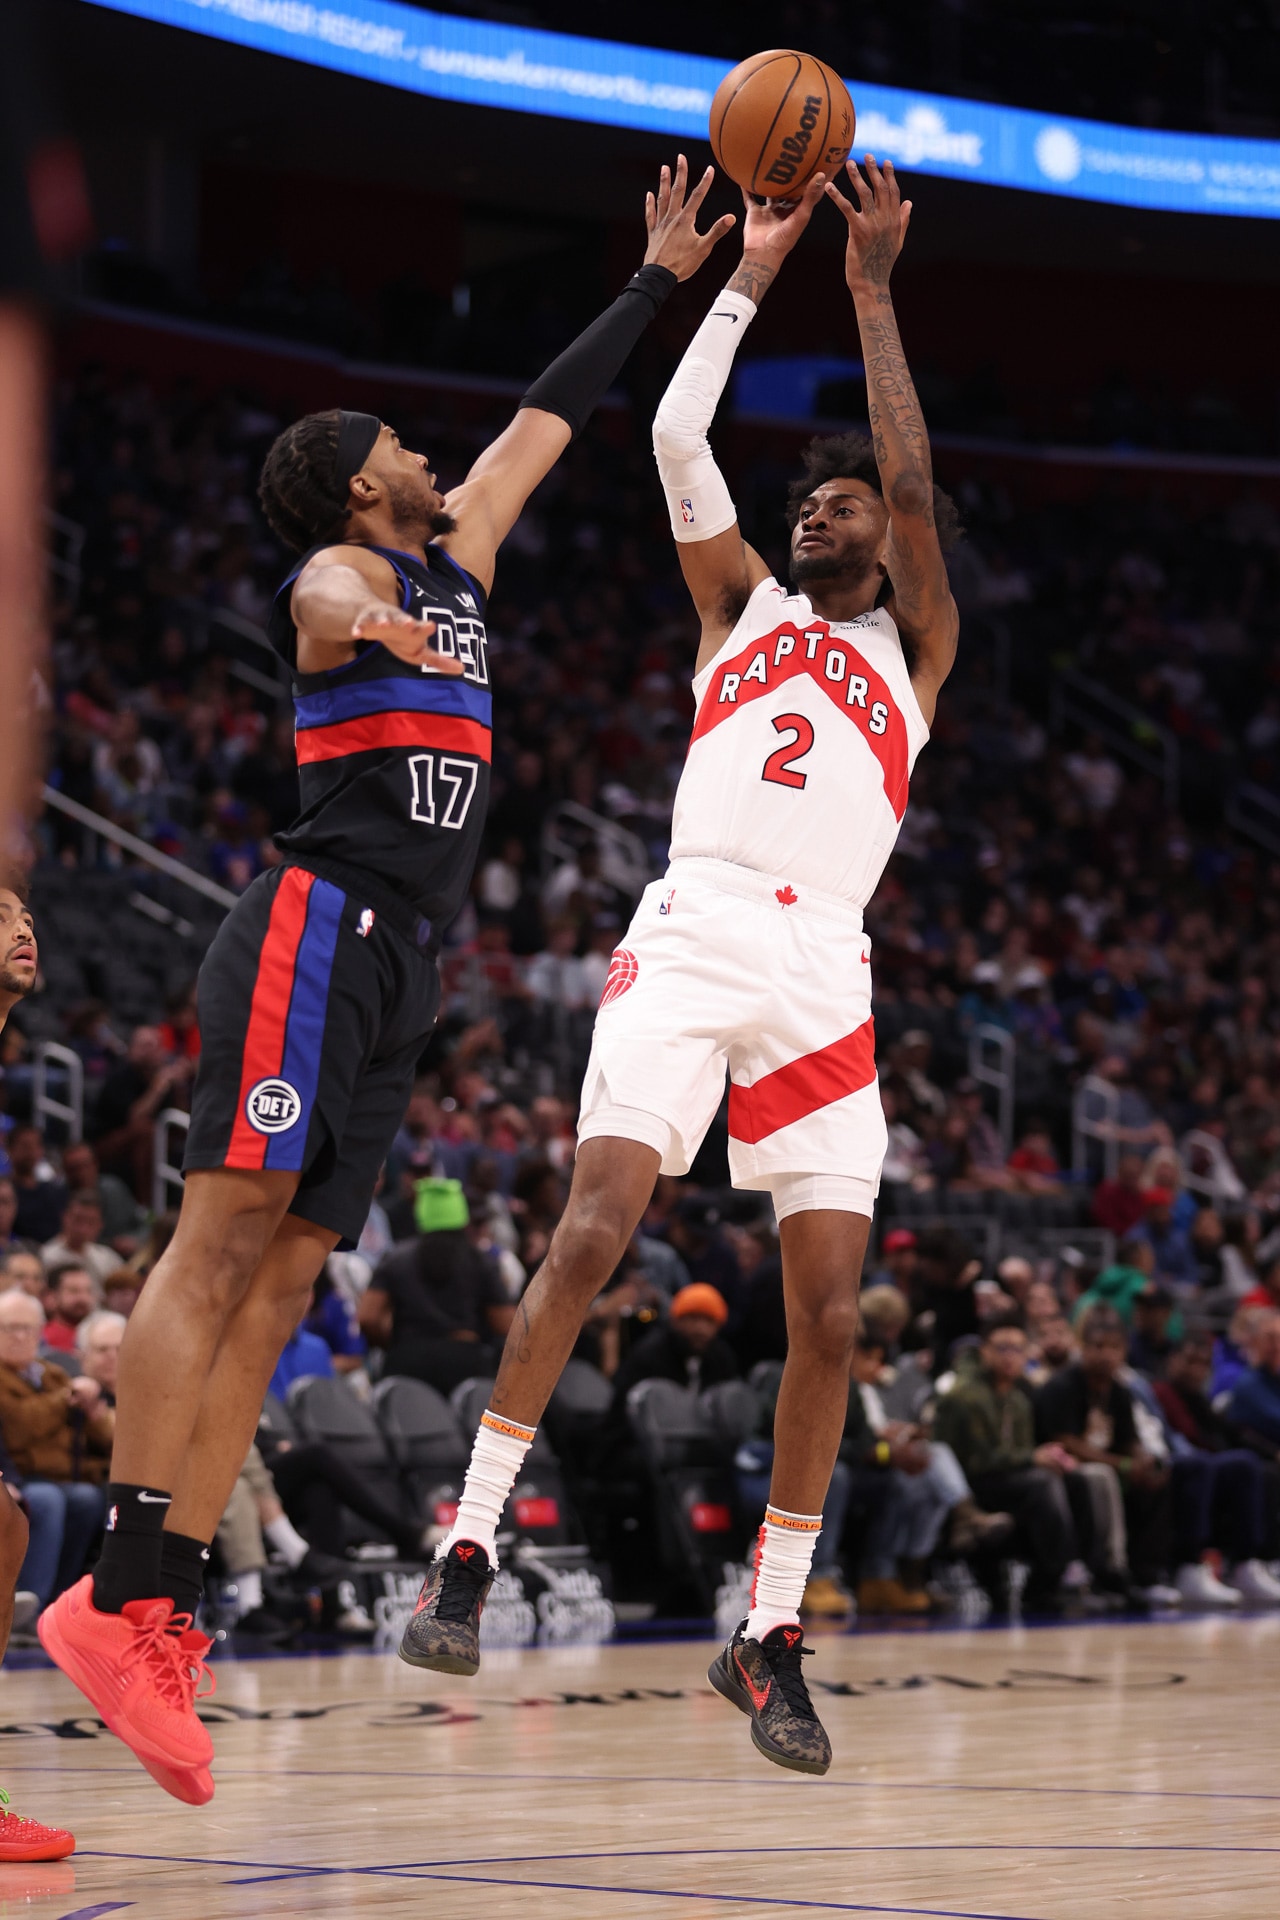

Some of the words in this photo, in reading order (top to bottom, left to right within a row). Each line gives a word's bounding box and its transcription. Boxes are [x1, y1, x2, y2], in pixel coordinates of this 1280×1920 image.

[764, 95, 823, 185] Wilson
[861, 620, 881, 629] Life
[718, 631, 889, 736] RAPTORS
[762, 712, 815, 790] 2
[408, 753, 478, 830] 17
[257, 1093, 293, 1119] DET
[783, 1519, 808, 1529] NBA
